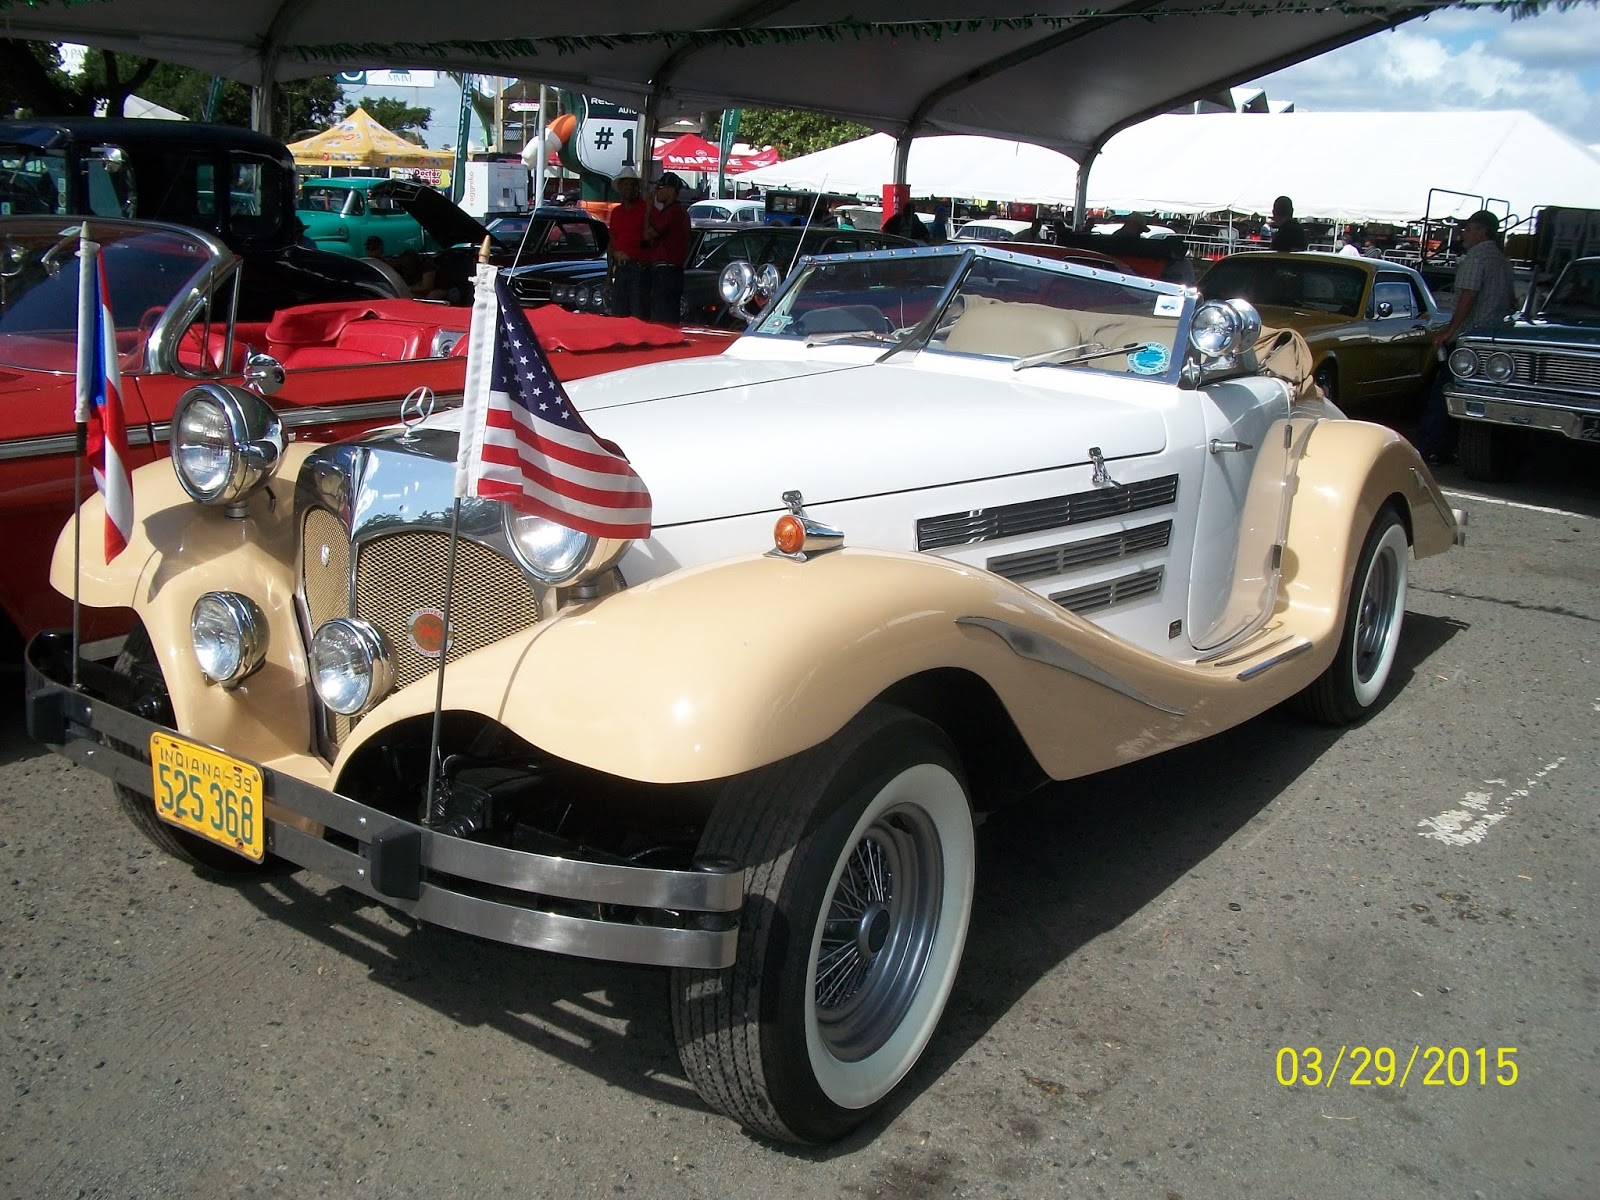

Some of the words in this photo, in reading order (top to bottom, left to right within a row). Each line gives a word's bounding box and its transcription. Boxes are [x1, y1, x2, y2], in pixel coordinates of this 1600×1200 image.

[418, 609, 443, 618] DRIVER
[158, 762, 204, 822] 525
[209, 782, 254, 845] 368
